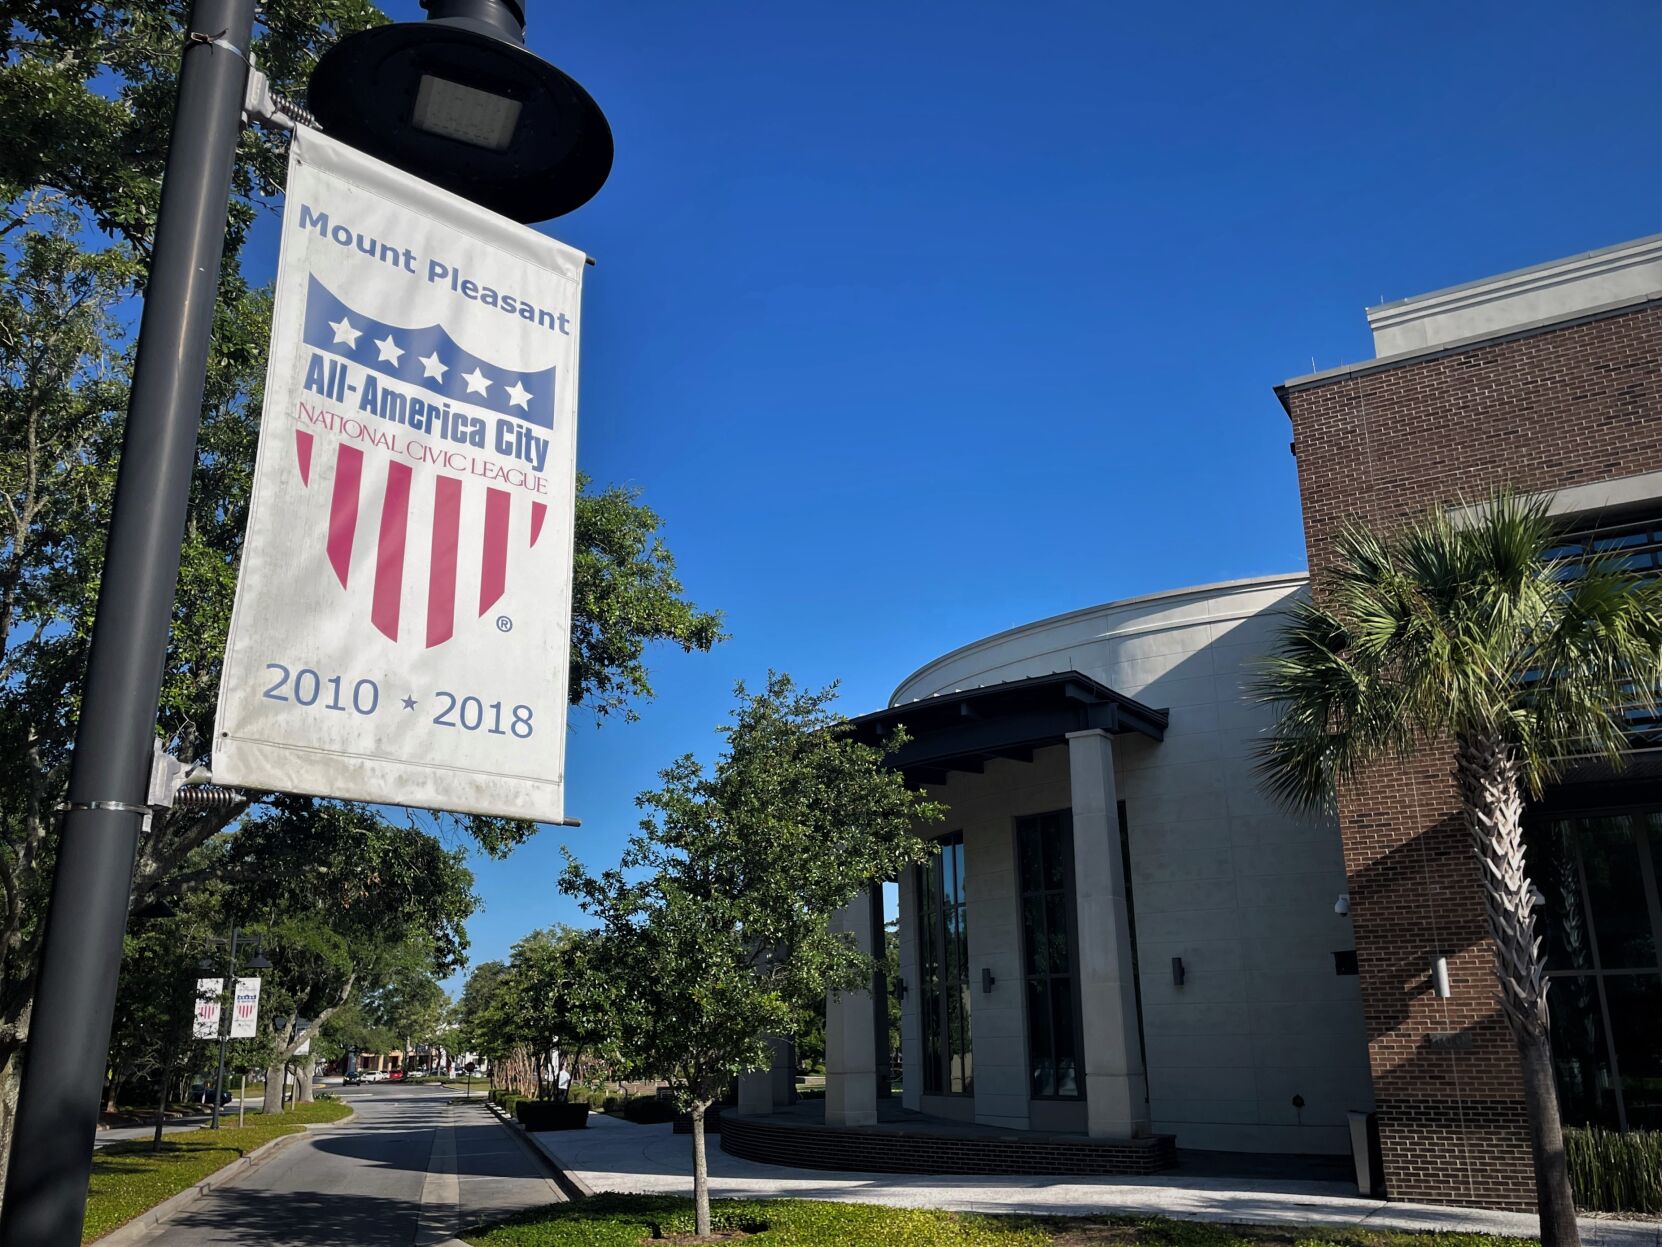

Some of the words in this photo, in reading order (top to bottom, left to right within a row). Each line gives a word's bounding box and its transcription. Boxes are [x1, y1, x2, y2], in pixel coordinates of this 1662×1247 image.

[299, 204, 416, 274] Mount
[427, 260, 570, 335] Pleasant
[298, 401, 402, 454] NATIONAL
[407, 440, 467, 471] CIVIC
[471, 457, 548, 494] LEAGUE
[304, 353, 487, 449] All-America
[495, 418, 549, 472] City
[263, 663, 379, 715] 2010
[432, 691, 534, 738] 2018
